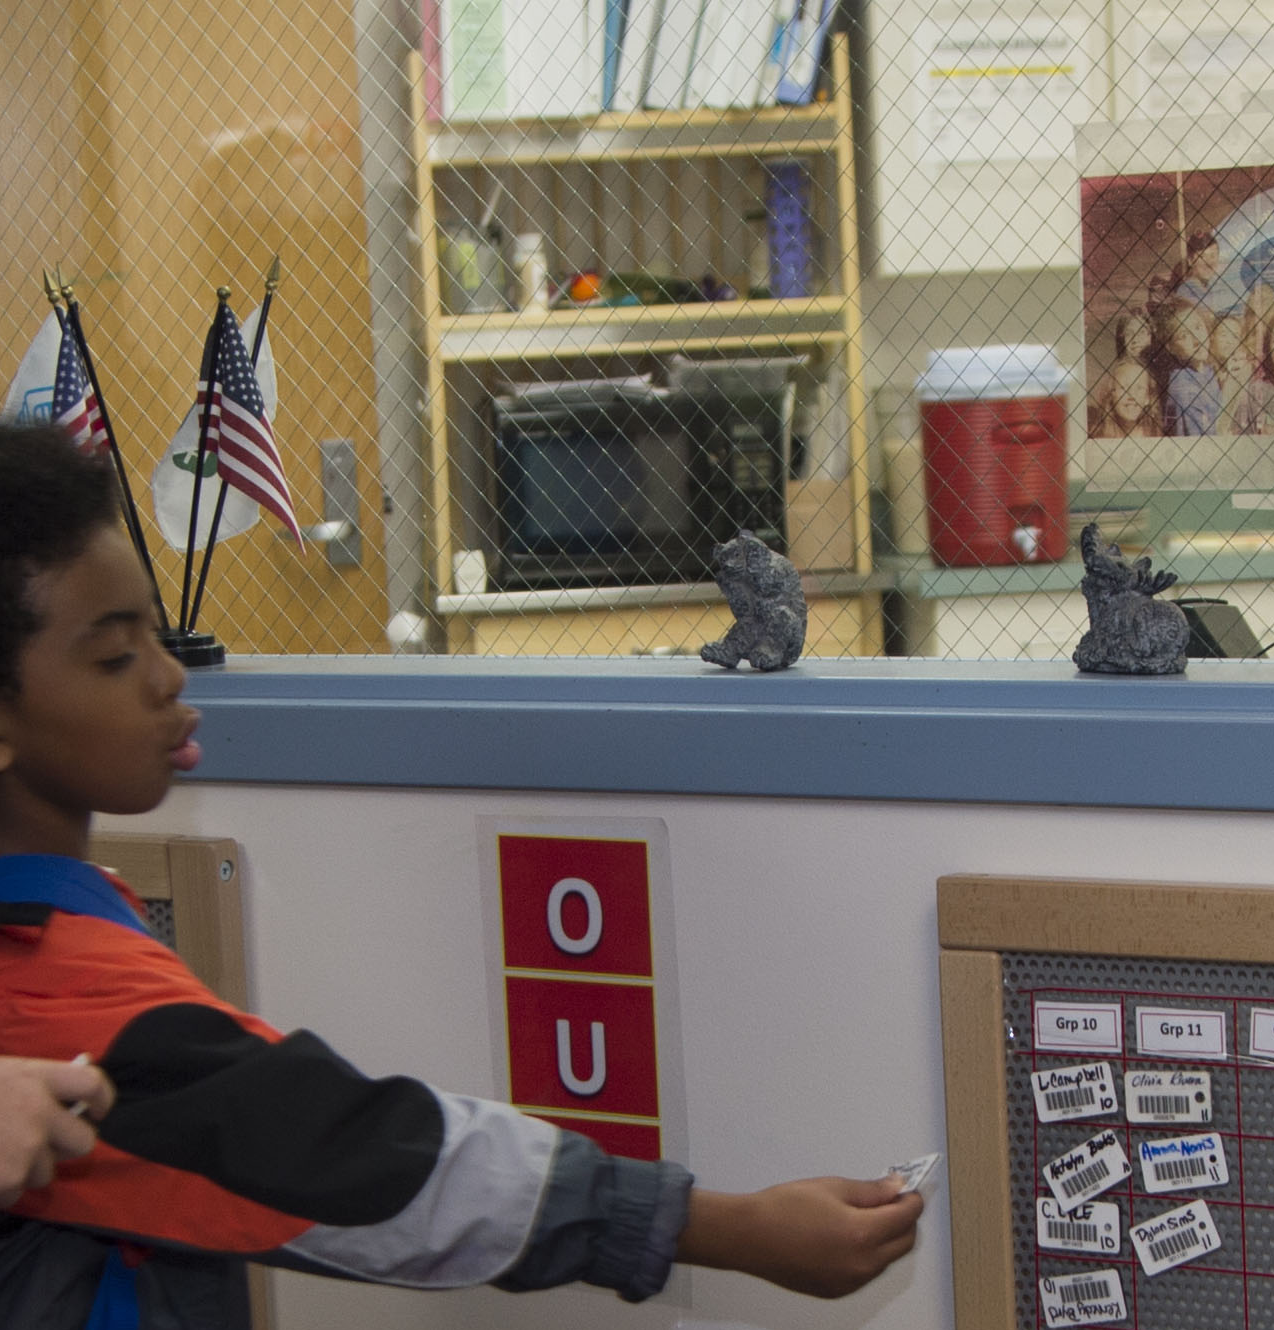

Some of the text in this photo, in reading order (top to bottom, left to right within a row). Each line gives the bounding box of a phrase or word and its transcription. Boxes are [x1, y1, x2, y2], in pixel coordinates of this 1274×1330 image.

[1056, 1016, 1097, 1033] Grp 10
[1160, 1022, 1202, 1038] Grp 11
[1100, 1097, 1113, 1111] 10
[1200, 1108, 1209, 1121] 11
[1135, 1208, 1196, 1243] Dylan Sims
[1100, 1235, 1115, 1250] 10
[1201, 1233, 1212, 1250] 11
